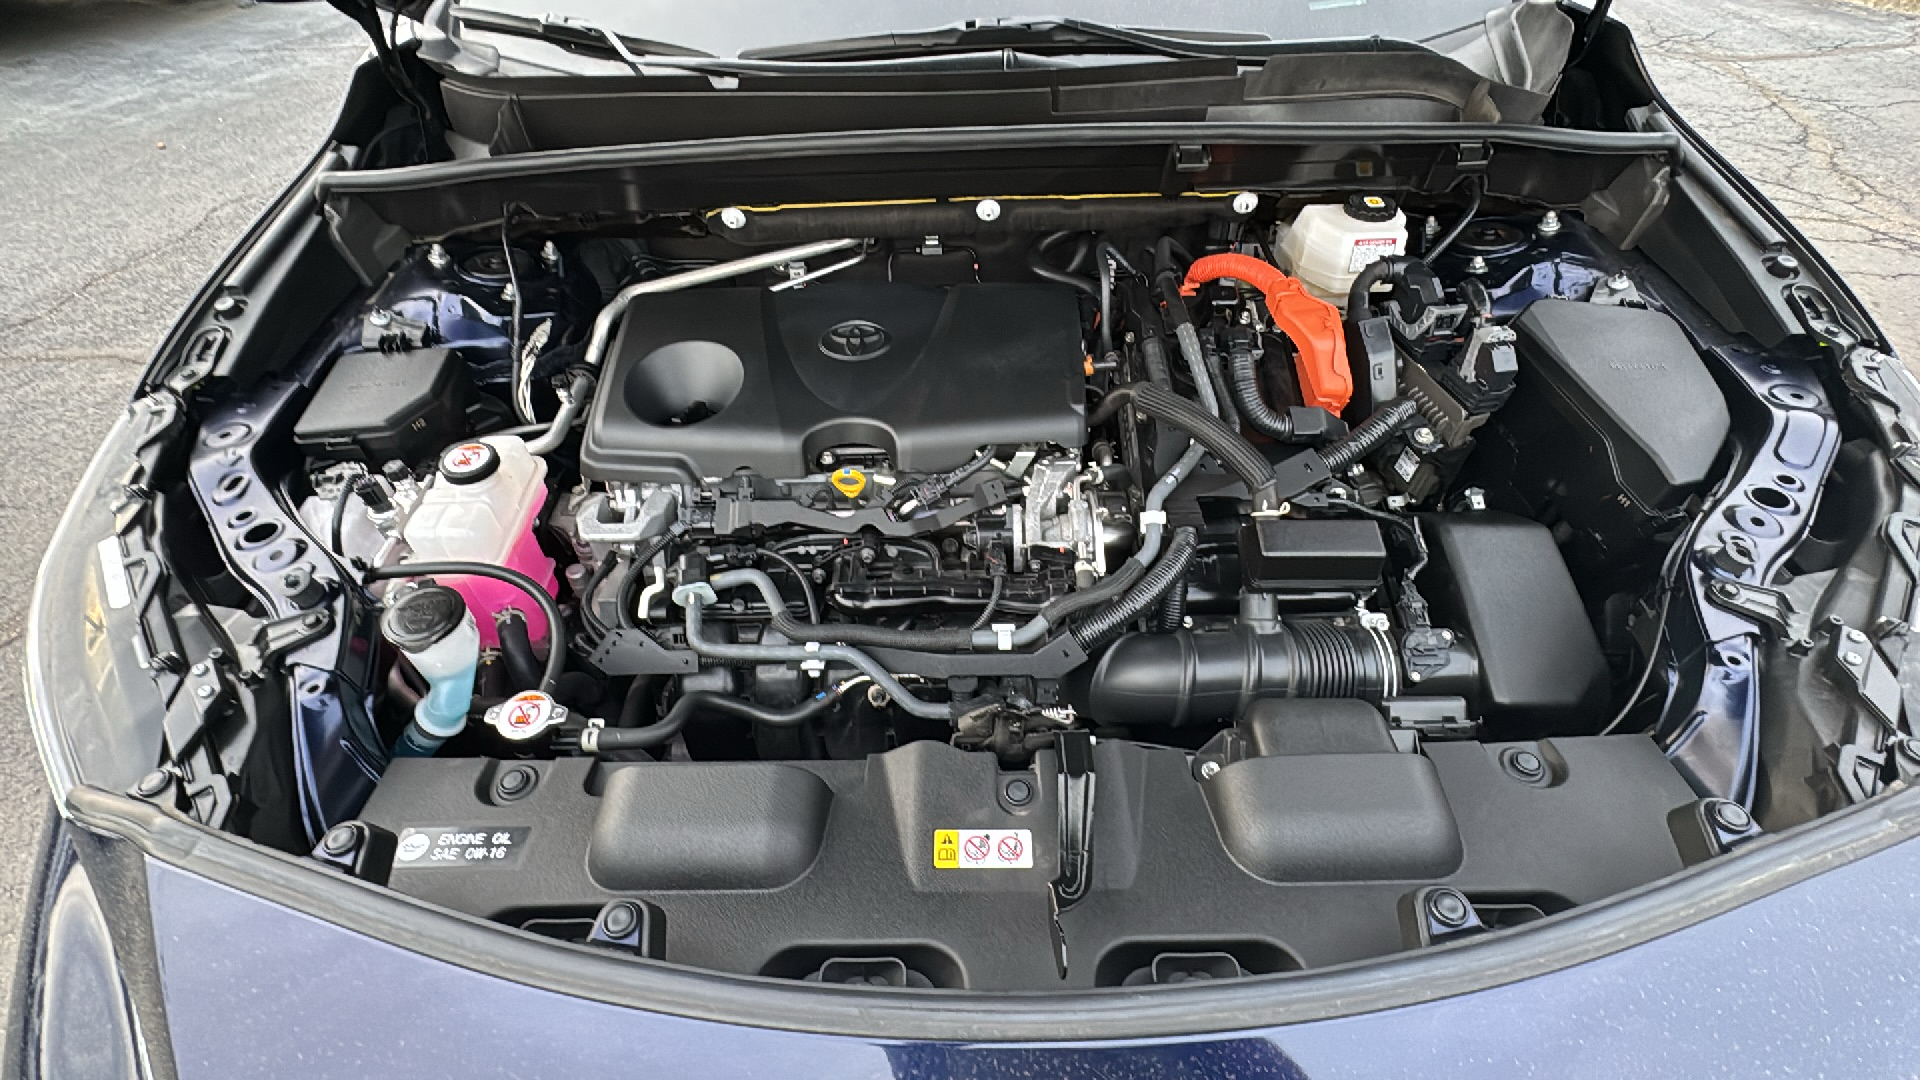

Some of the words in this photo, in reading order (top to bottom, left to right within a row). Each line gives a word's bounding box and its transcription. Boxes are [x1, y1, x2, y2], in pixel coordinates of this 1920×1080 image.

[438, 833, 487, 845] ENGINE
[491, 832, 512, 845] OIL
[430, 847, 460, 860] SAE
